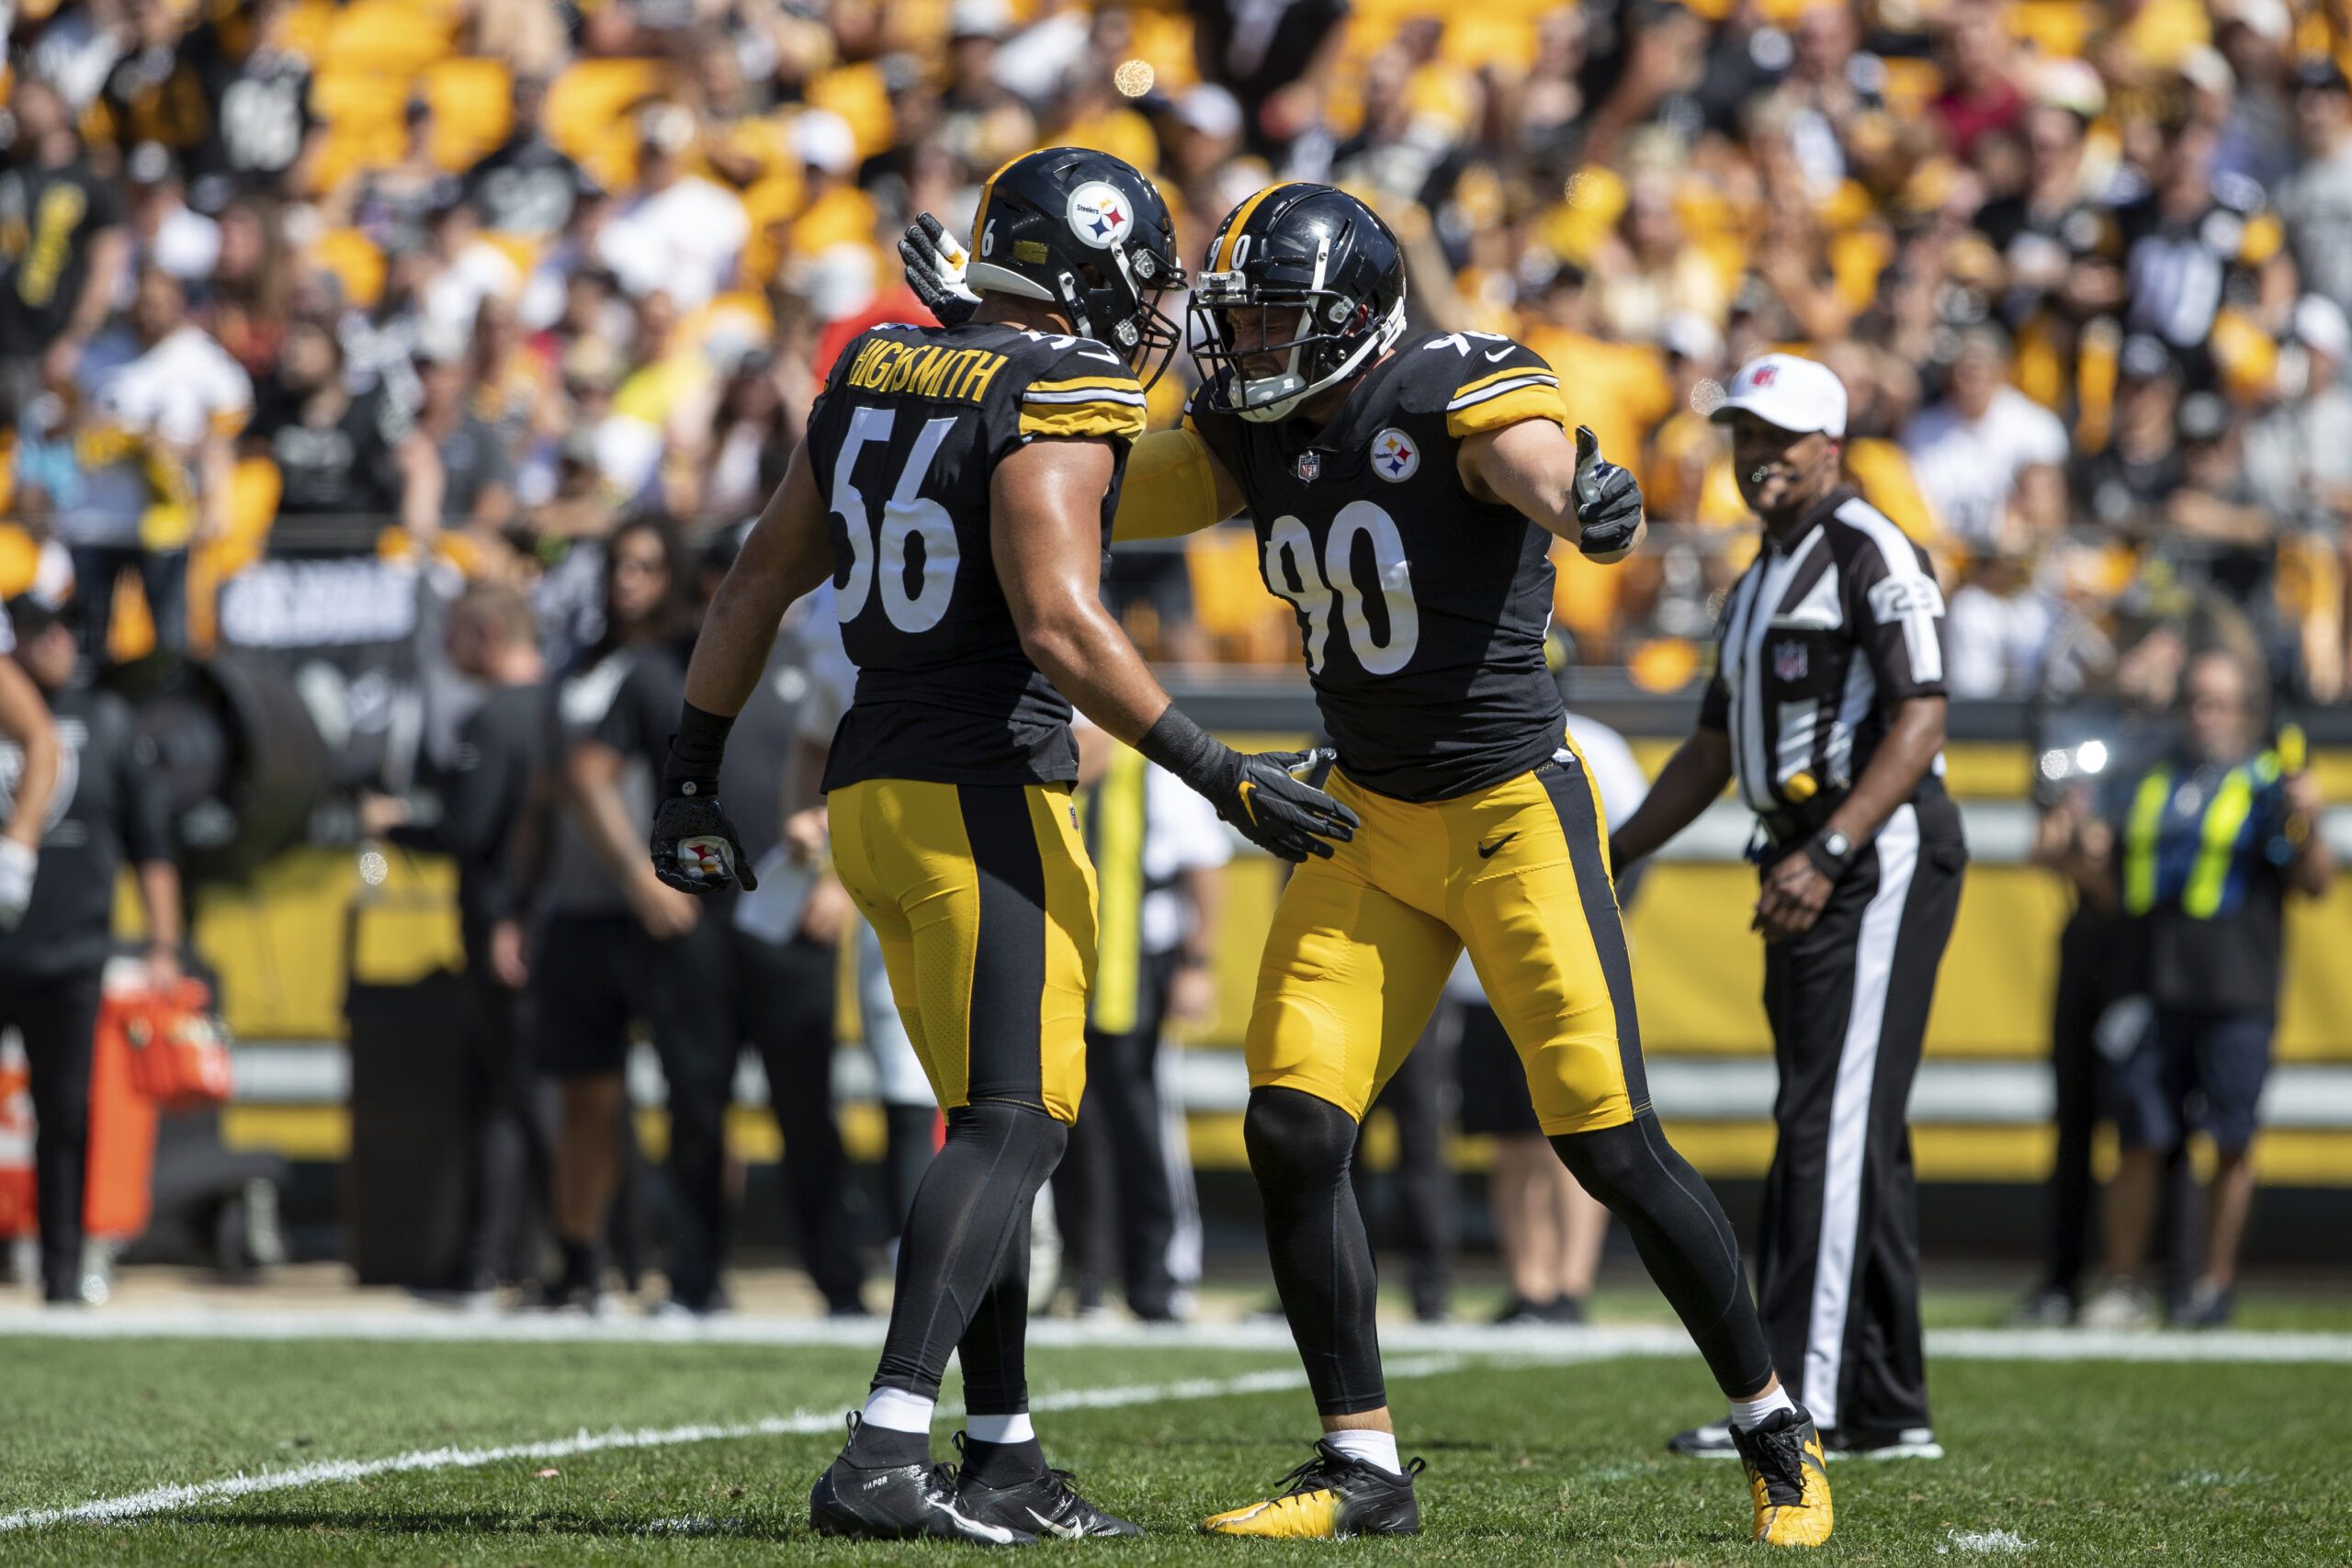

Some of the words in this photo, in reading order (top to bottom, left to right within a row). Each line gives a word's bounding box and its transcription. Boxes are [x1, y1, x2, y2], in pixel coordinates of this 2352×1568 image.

[1076, 204, 1100, 215] Steelers
[1208, 234, 1251, 271] 90
[829, 406, 961, 634] 56
[1265, 501, 1419, 675] 90
[863, 1475, 888, 1491] VAPOR
